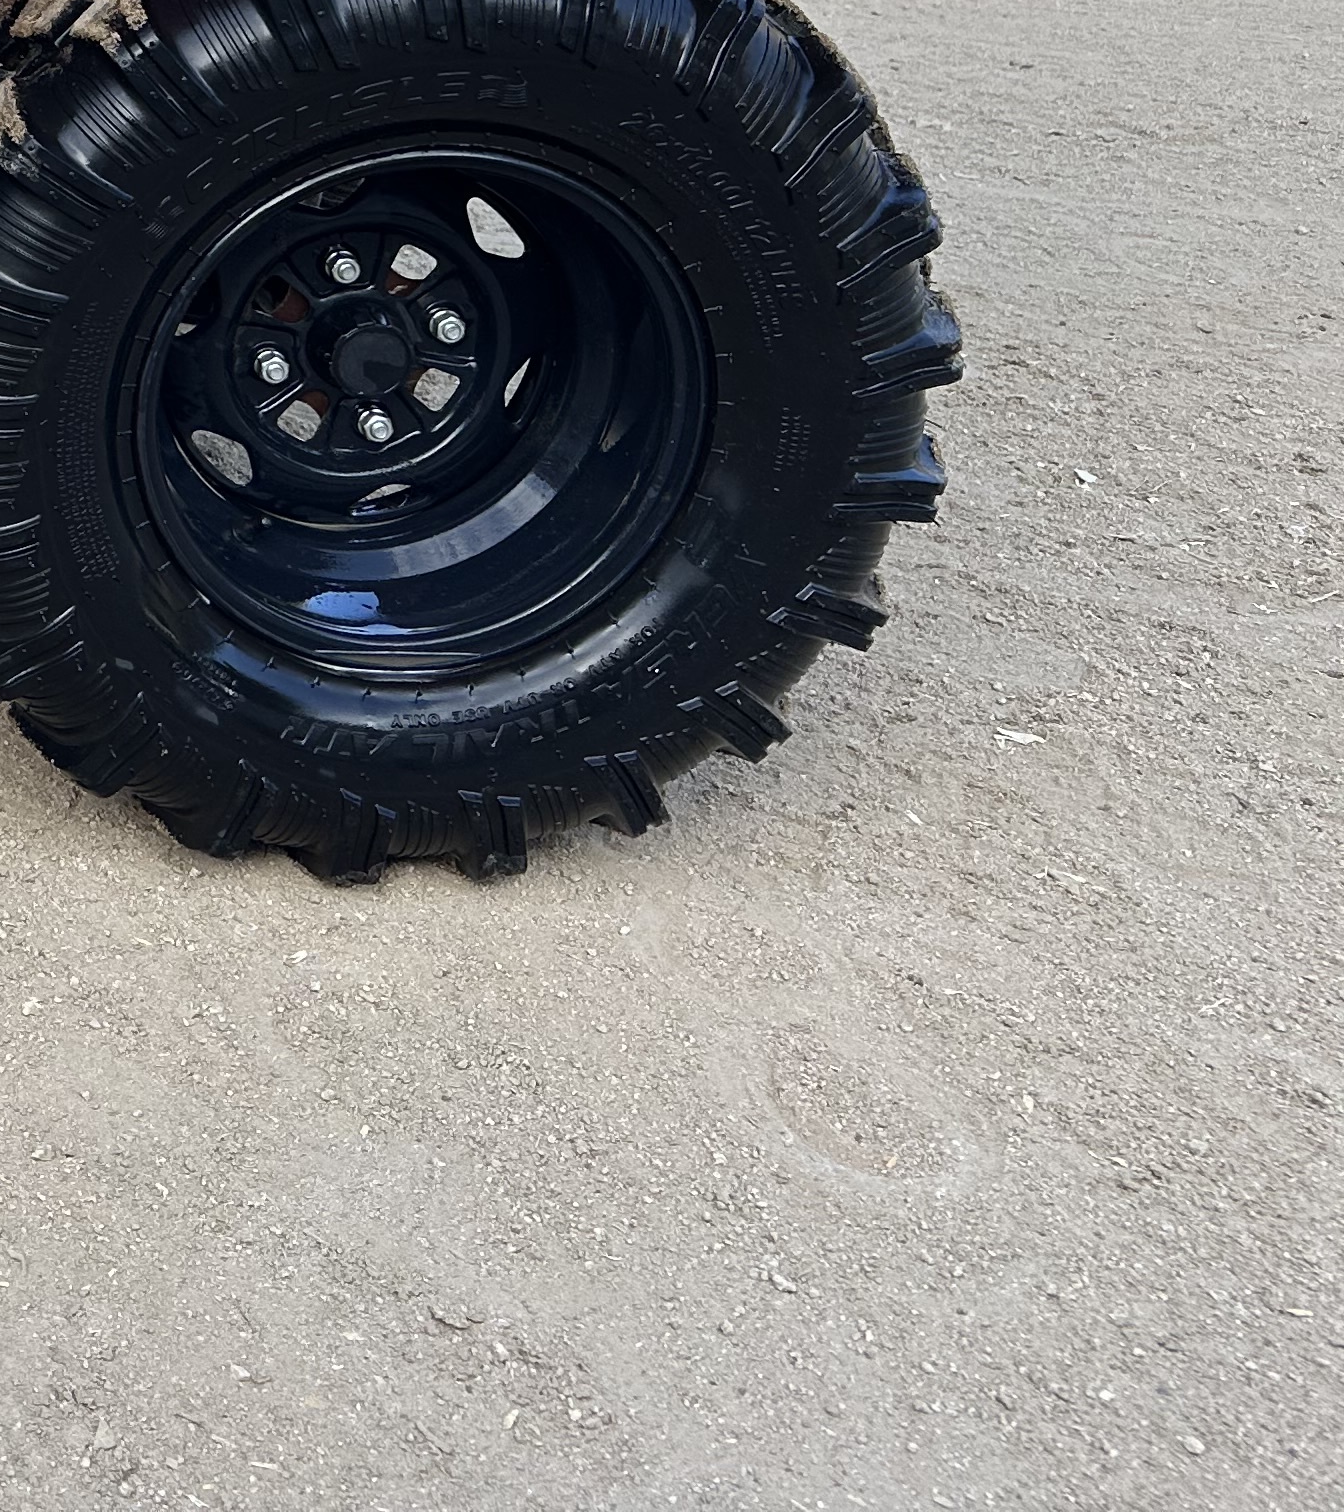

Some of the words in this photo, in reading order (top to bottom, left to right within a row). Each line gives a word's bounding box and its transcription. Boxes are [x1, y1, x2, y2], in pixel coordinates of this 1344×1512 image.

[172, 71, 471, 202] CARLISLE
[389, 712, 441, 728] ONLY
[452, 704, 490, 724] USE
